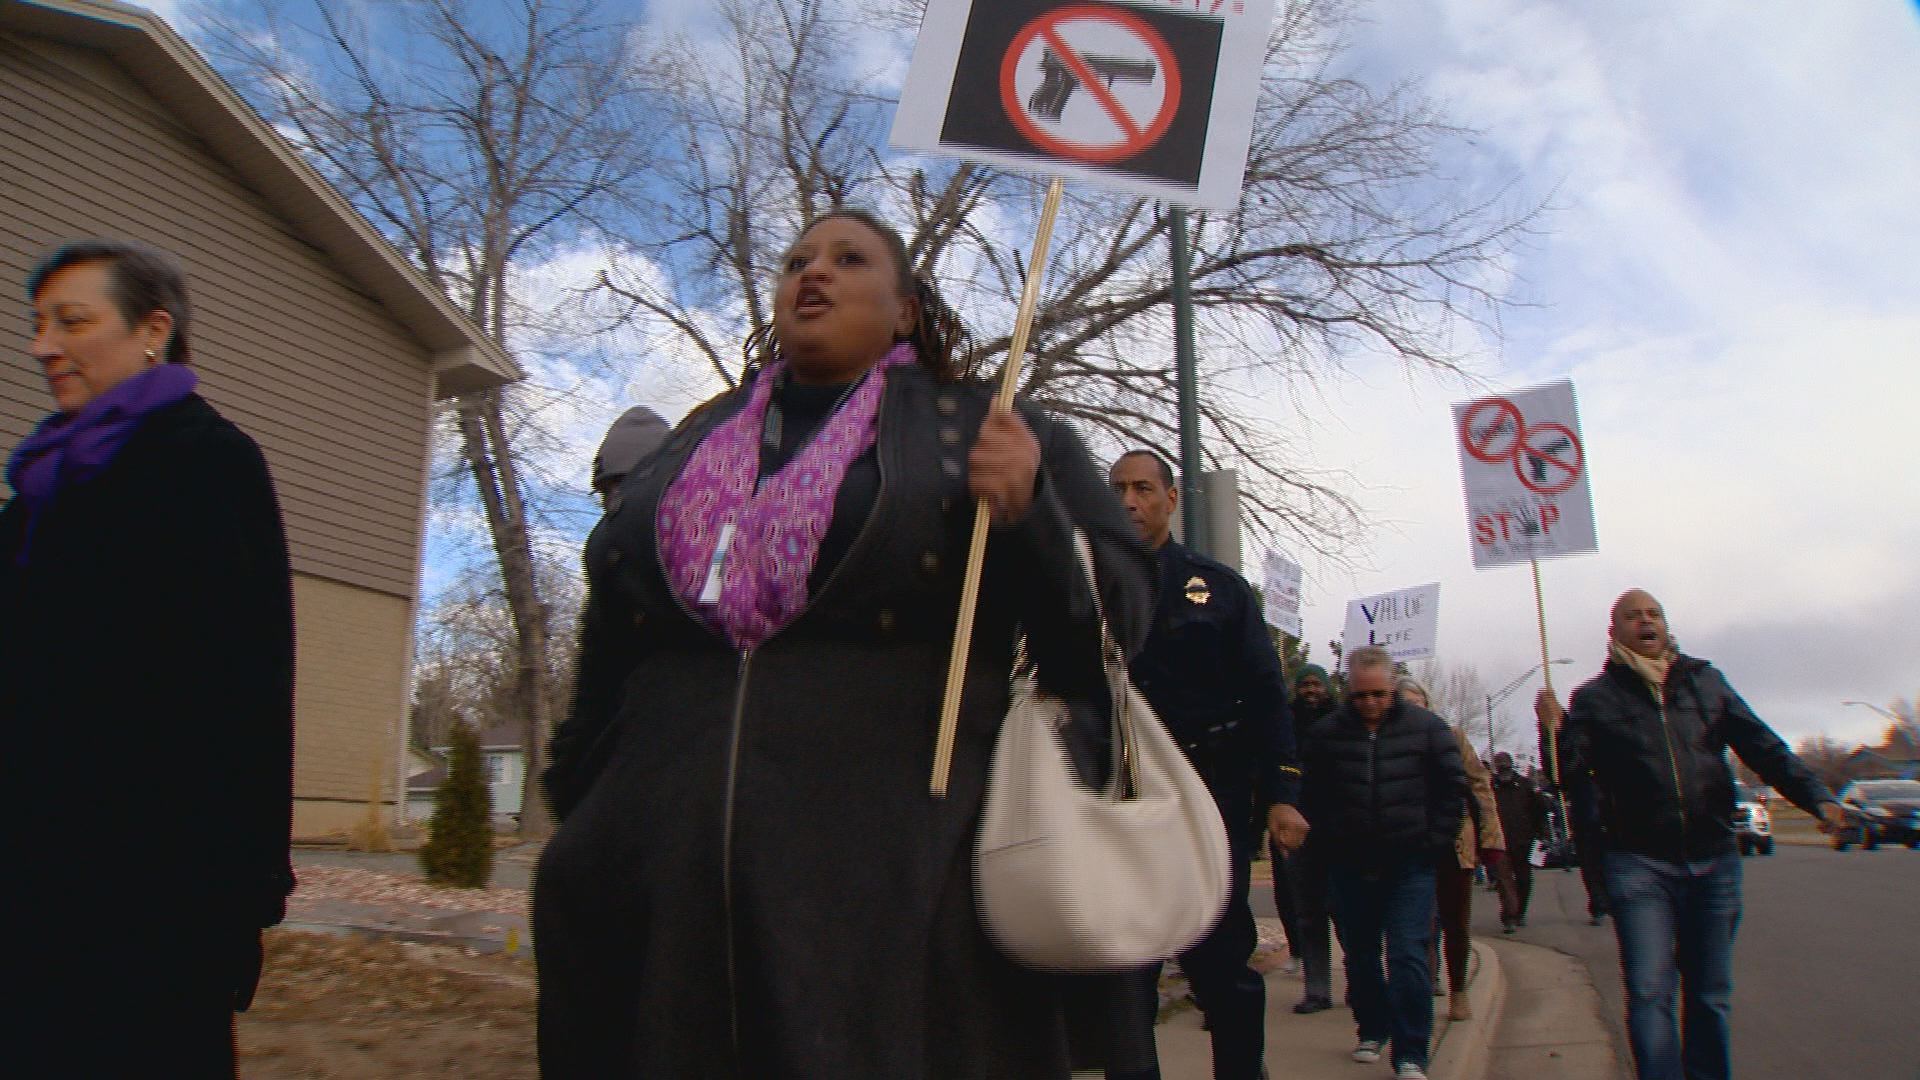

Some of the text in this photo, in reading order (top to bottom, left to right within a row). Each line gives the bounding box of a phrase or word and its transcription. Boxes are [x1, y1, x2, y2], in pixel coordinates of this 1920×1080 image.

[1474, 502, 1560, 545] STP
[1360, 593, 1425, 624] VALUE
[1368, 628, 1414, 647] LIFE
